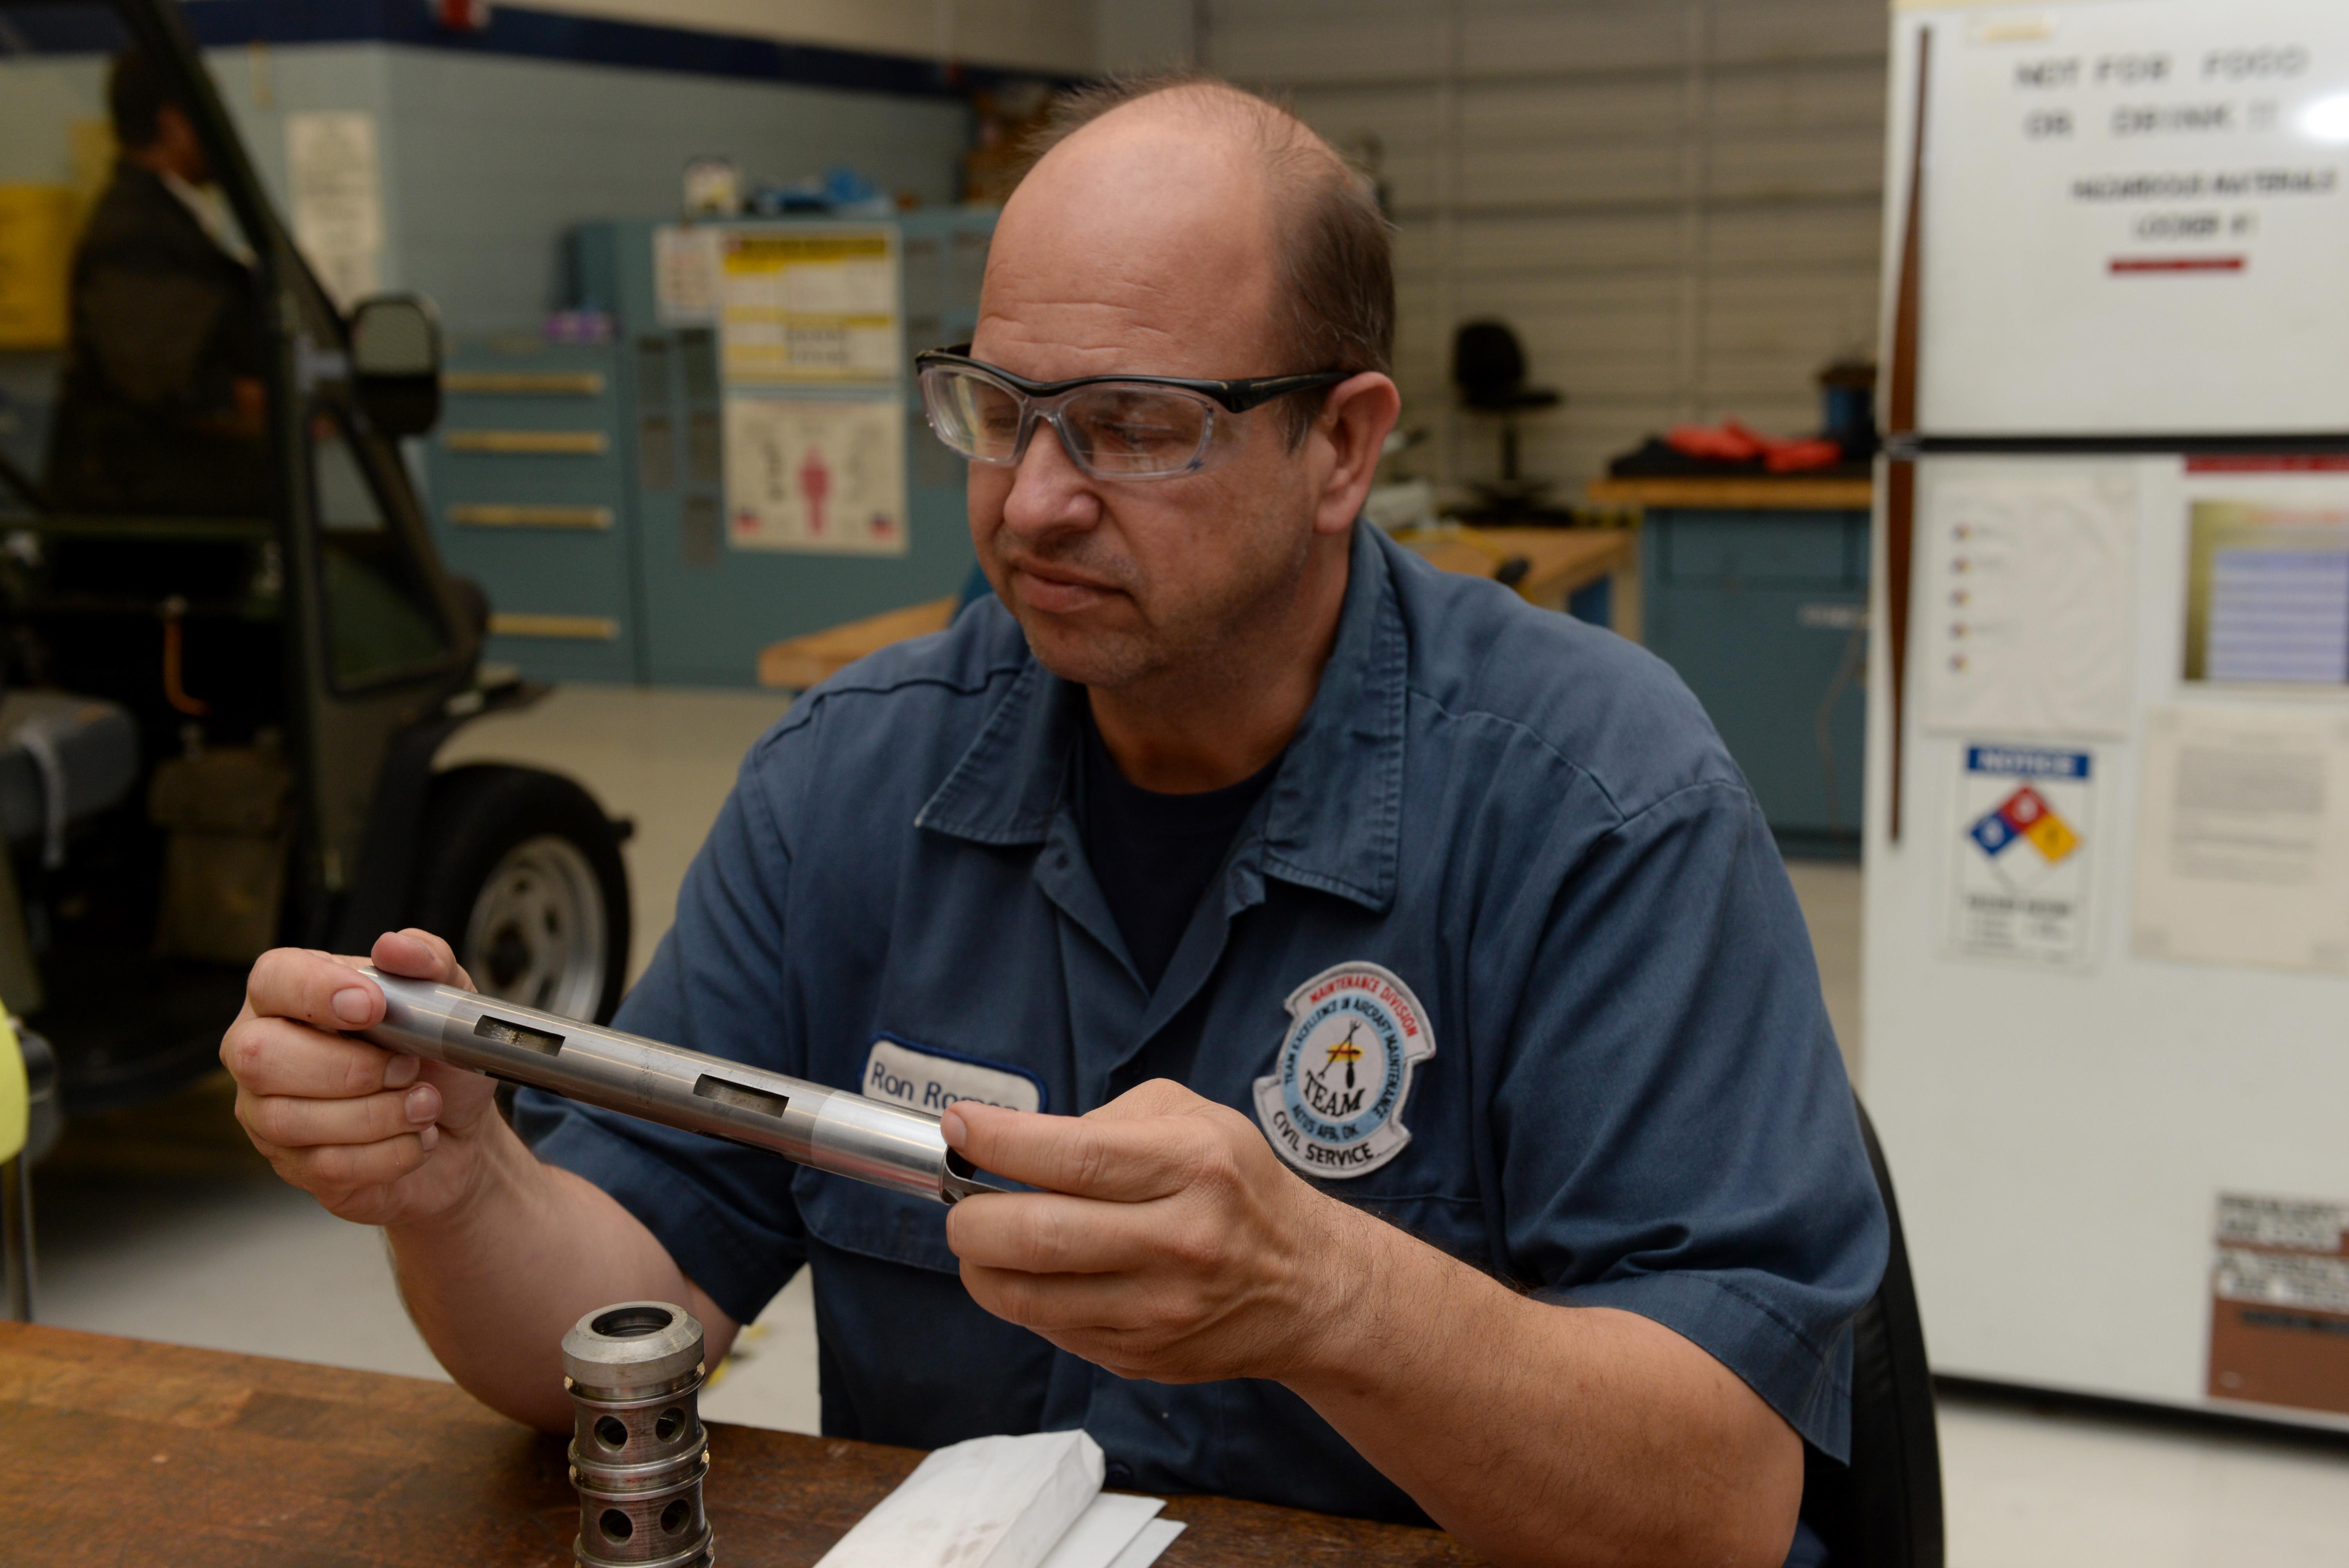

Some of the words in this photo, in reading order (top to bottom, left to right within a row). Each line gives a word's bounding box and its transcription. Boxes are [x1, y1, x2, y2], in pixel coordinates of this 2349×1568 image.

[2015, 57, 2080, 87] NOT
[2096, 53, 2169, 80] FOR
[2203, 48, 2308, 77] FOOD
[2025, 108, 2073, 137] OR
[2112, 102, 2233, 134] DRINK
[1310, 975, 1380, 1004] MAINTENANCE
[1380, 985, 1418, 1037] DIVISION
[1341, 998, 1350, 1010] IN
[1353, 998, 1392, 1033] AIRCRAFT
[1292, 1000, 1337, 1050] EXCELLENCE
[870, 1061, 914, 1101] Ron
[1284, 1053, 1295, 1085] TEAM
[1372, 1033, 1400, 1119] MAINTENANCE
[1305, 1069, 1365, 1117] TEAM
[1274, 1111, 1299, 1151] CIVIL
[1306, 1142, 1374, 1165] SERVICE
